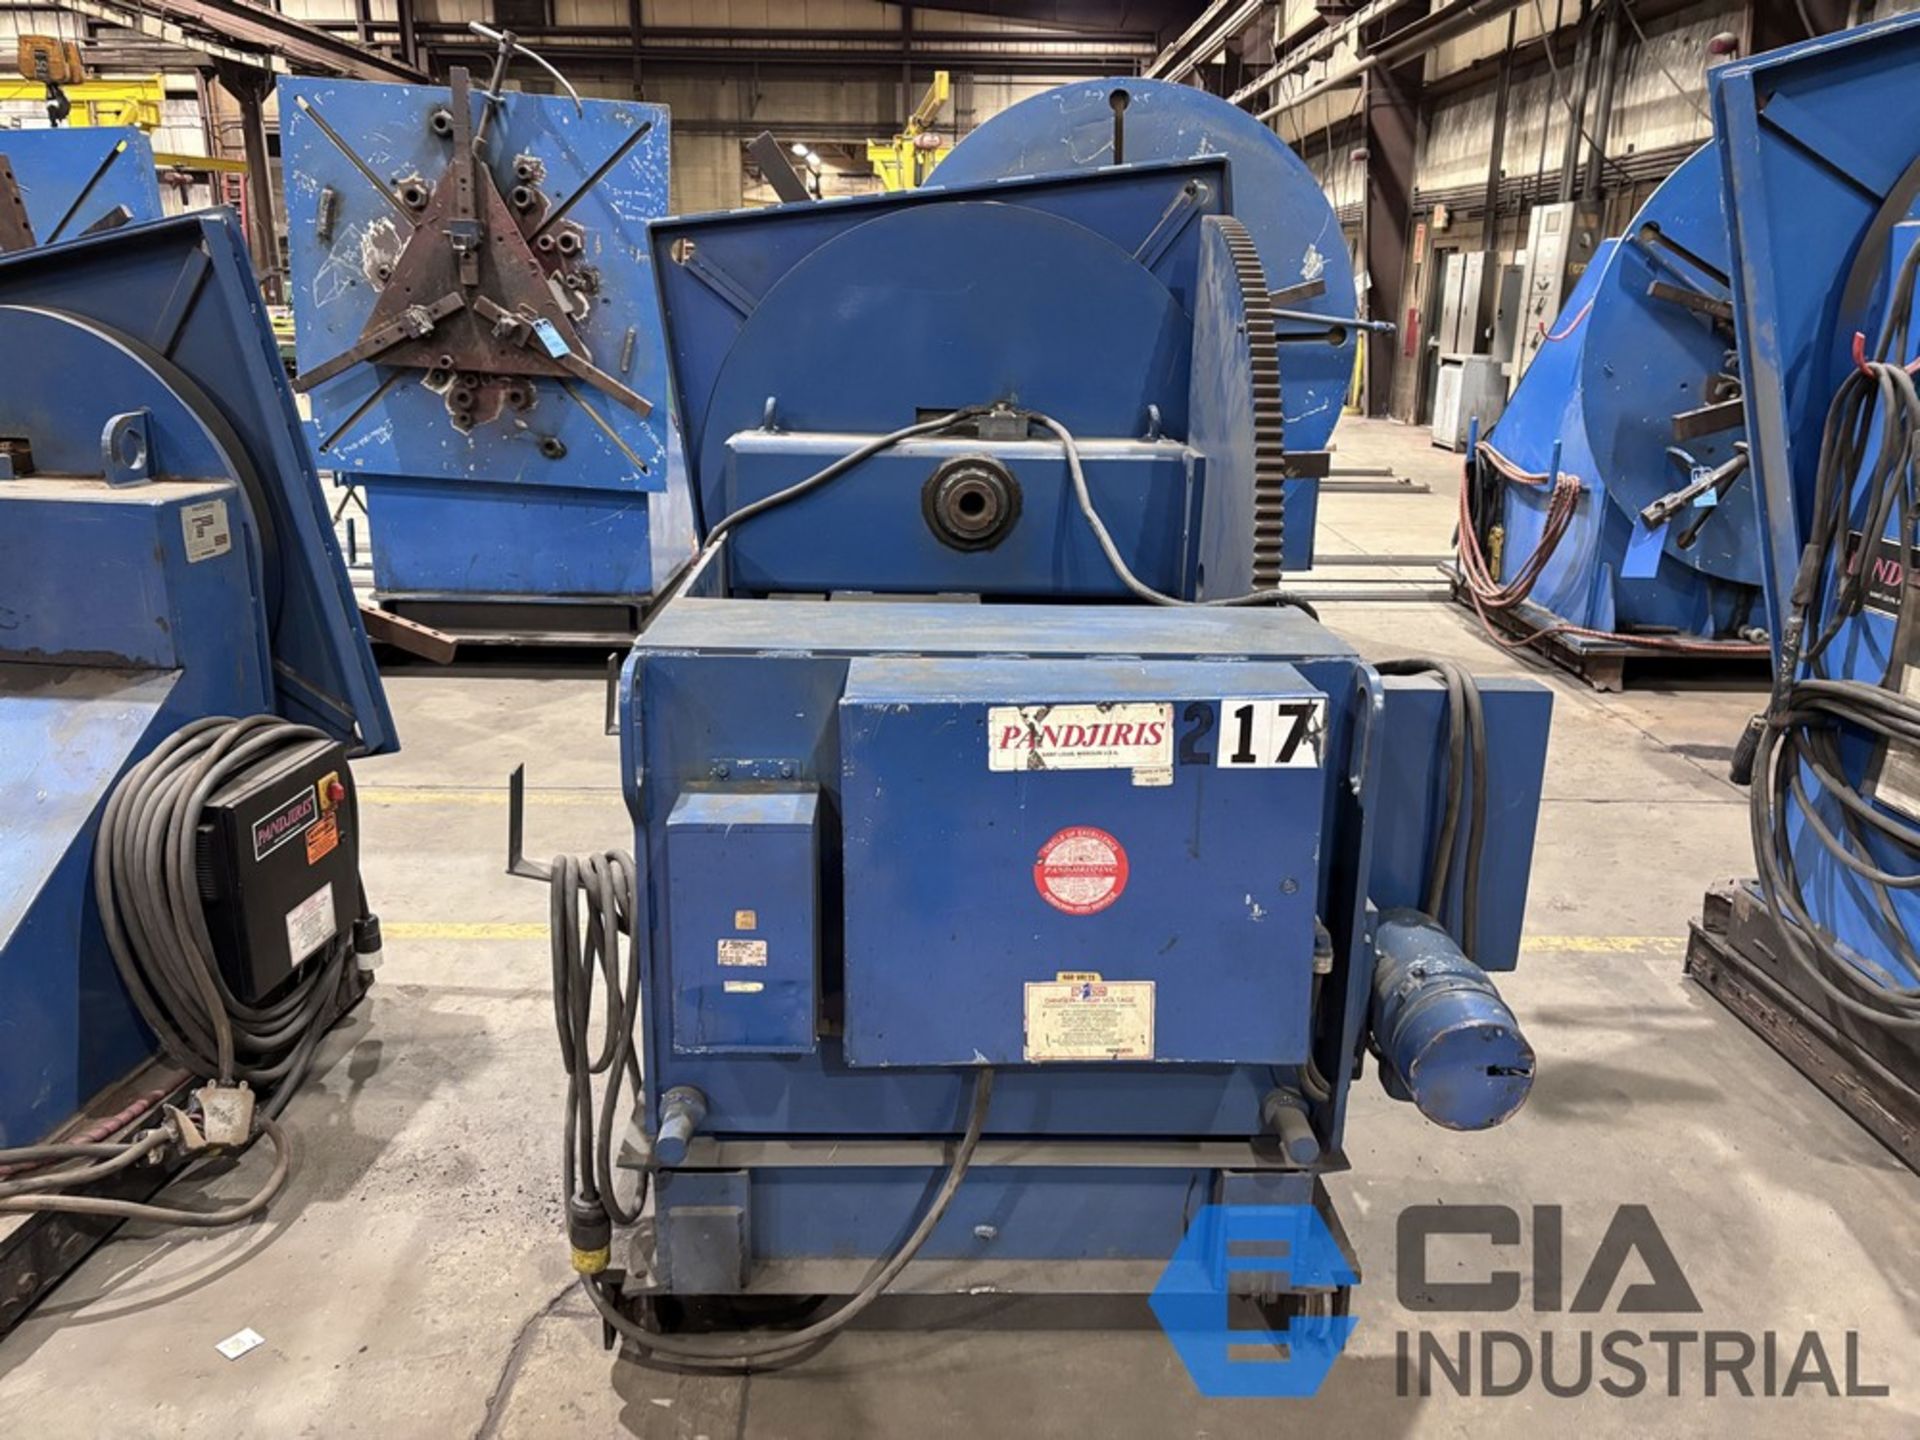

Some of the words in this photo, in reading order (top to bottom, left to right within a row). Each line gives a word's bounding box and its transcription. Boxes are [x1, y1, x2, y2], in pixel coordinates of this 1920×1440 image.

[999, 720, 1166, 750] PANDJIRIS
[1179, 702, 1319, 766] 217
[257, 800, 313, 846] PANDJIRIS
